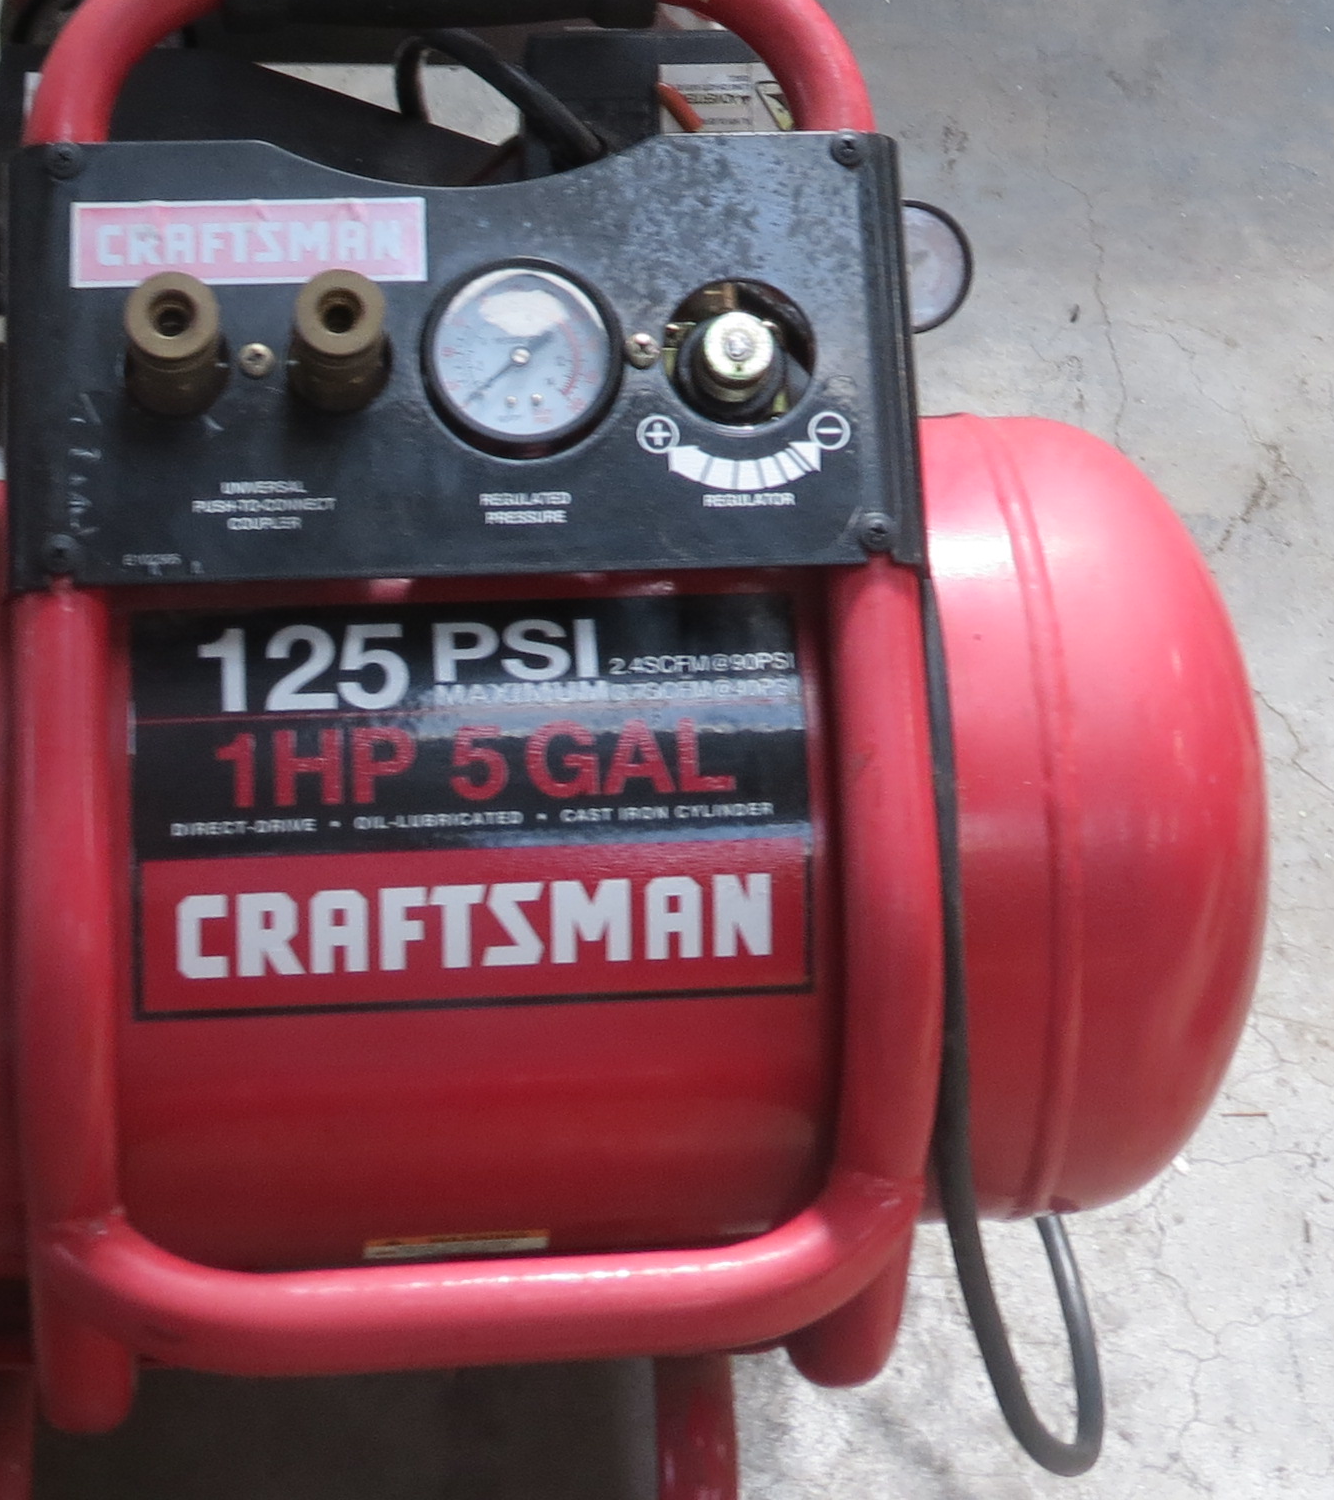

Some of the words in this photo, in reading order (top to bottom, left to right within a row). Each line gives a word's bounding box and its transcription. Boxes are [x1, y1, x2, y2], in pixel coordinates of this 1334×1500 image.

[95, 219, 405, 266] CRAFTSMAN
[220, 480, 307, 494] UNIVERSAL
[191, 497, 337, 513] PUSH-TO-CONNECT
[479, 491, 572, 506] REGULATED
[703, 492, 795, 507] REGULATOR
[226, 516, 303, 530] COUPLER
[485, 510, 567, 525] PRESSURE
[197, 622, 410, 712] 125
[431, 617, 599, 683] PSI
[432, 680, 608, 705] MAXIMUM
[217, 726, 416, 808] 1HP
[450, 725, 509, 800] 5
[525, 717, 737, 798] GAL
[170, 818, 317, 837] DIRECT-DRIVE
[354, 810, 524, 830] OIL-LUBRICATED
[559, 807, 614, 823] CAST
[617, 805, 669, 821] IRON
[673, 802, 774, 819] CYLINDER
[174, 872, 773, 980] CRAFTSMAN
